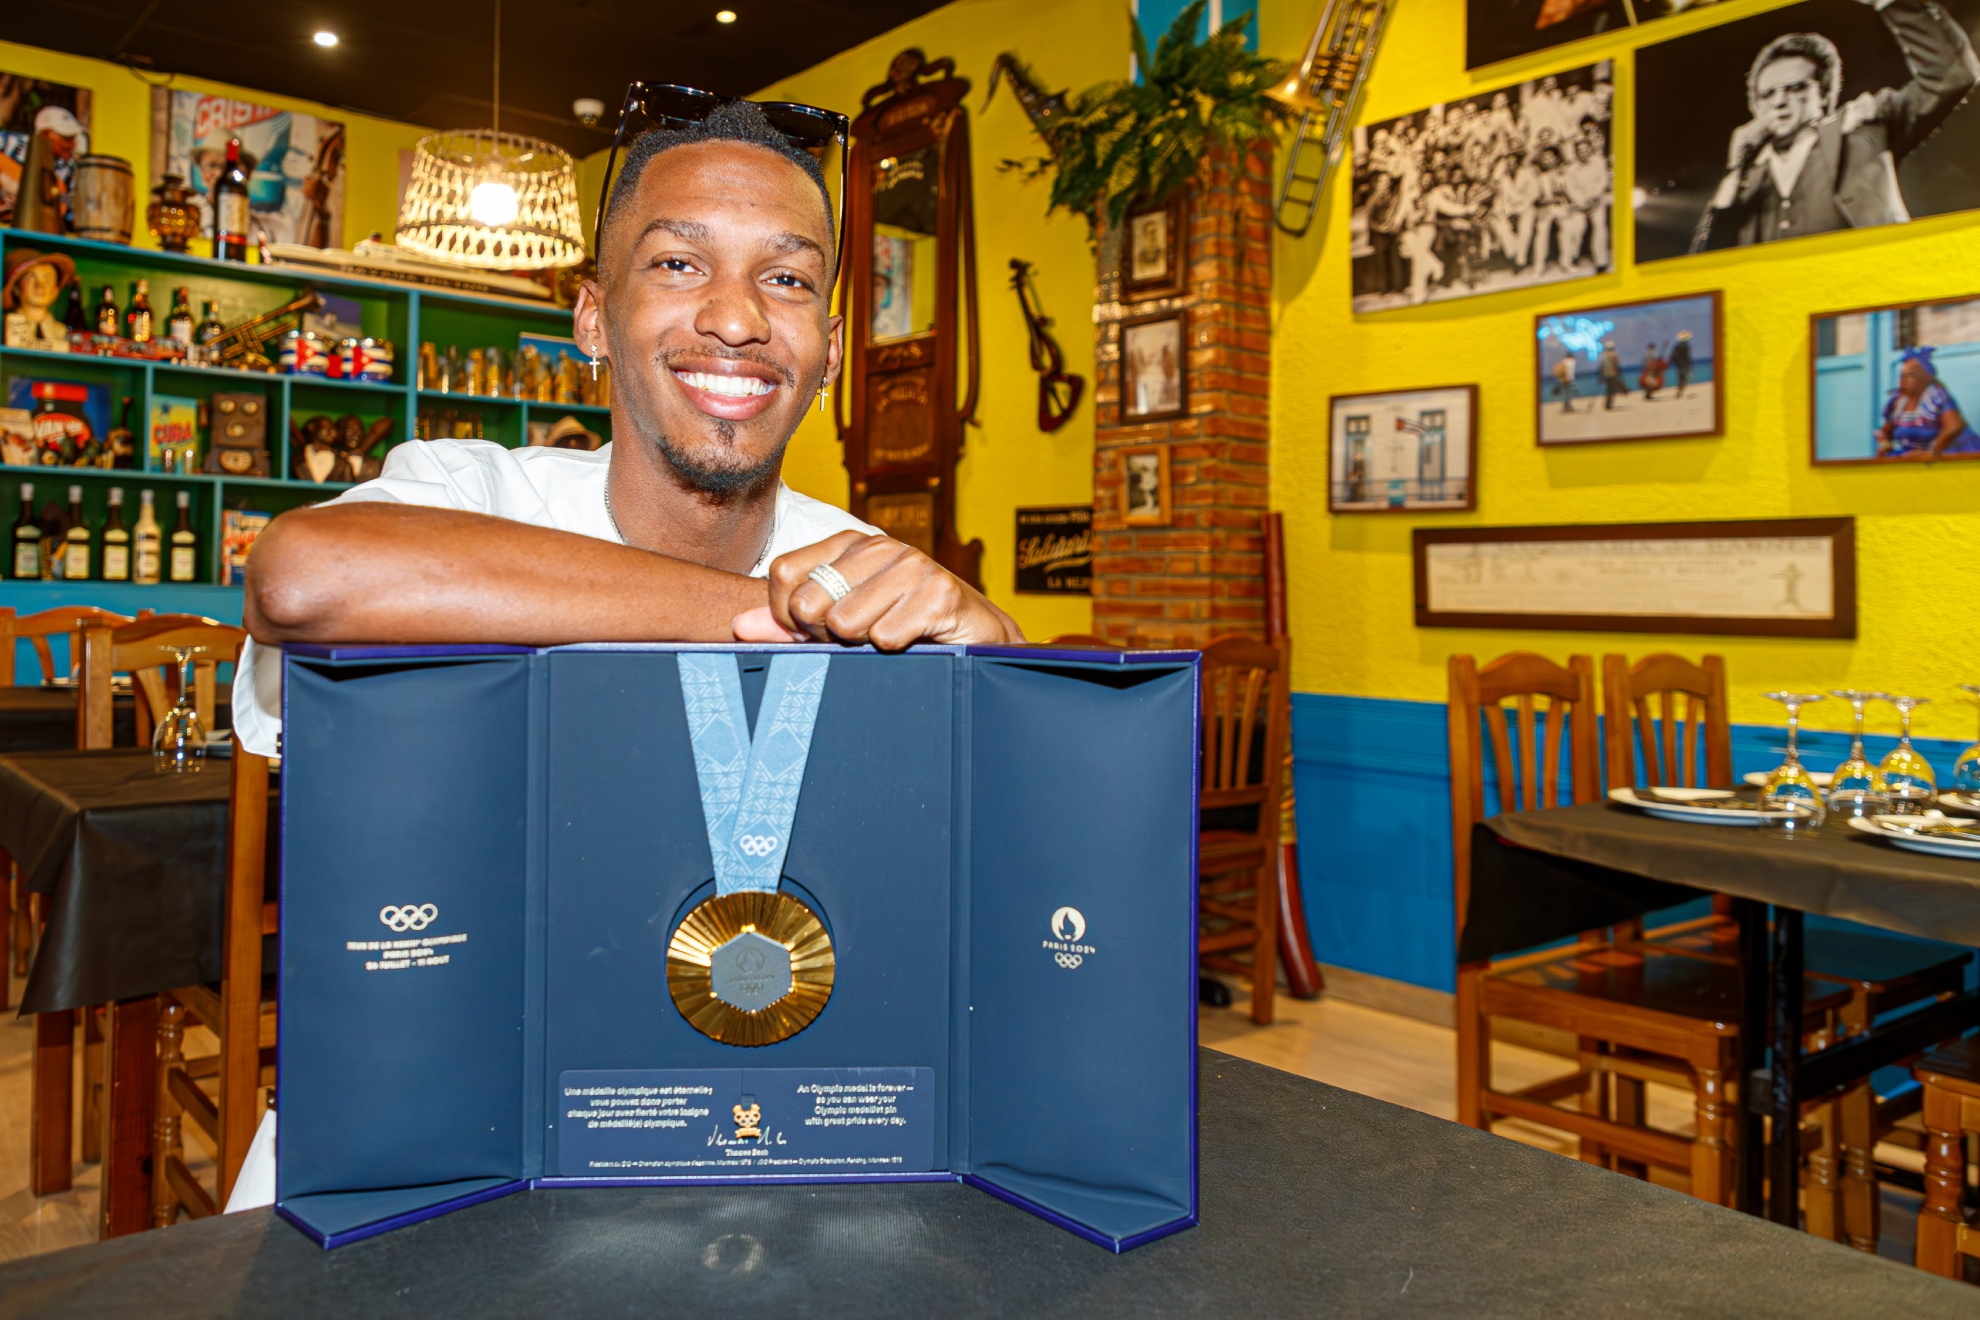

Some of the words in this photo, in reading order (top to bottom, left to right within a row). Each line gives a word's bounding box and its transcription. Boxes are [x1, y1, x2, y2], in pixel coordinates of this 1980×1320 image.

[1042, 940, 1068, 952] PARIS
[1070, 944, 1096, 954] 2024
[797, 1085, 810, 1094] An
[811, 1084, 843, 1095] Olympic
[877, 1084, 906, 1092] forever
[827, 1096, 841, 1105] you
[878, 1096, 896, 1105] your
[814, 1105, 846, 1116] Olympic
